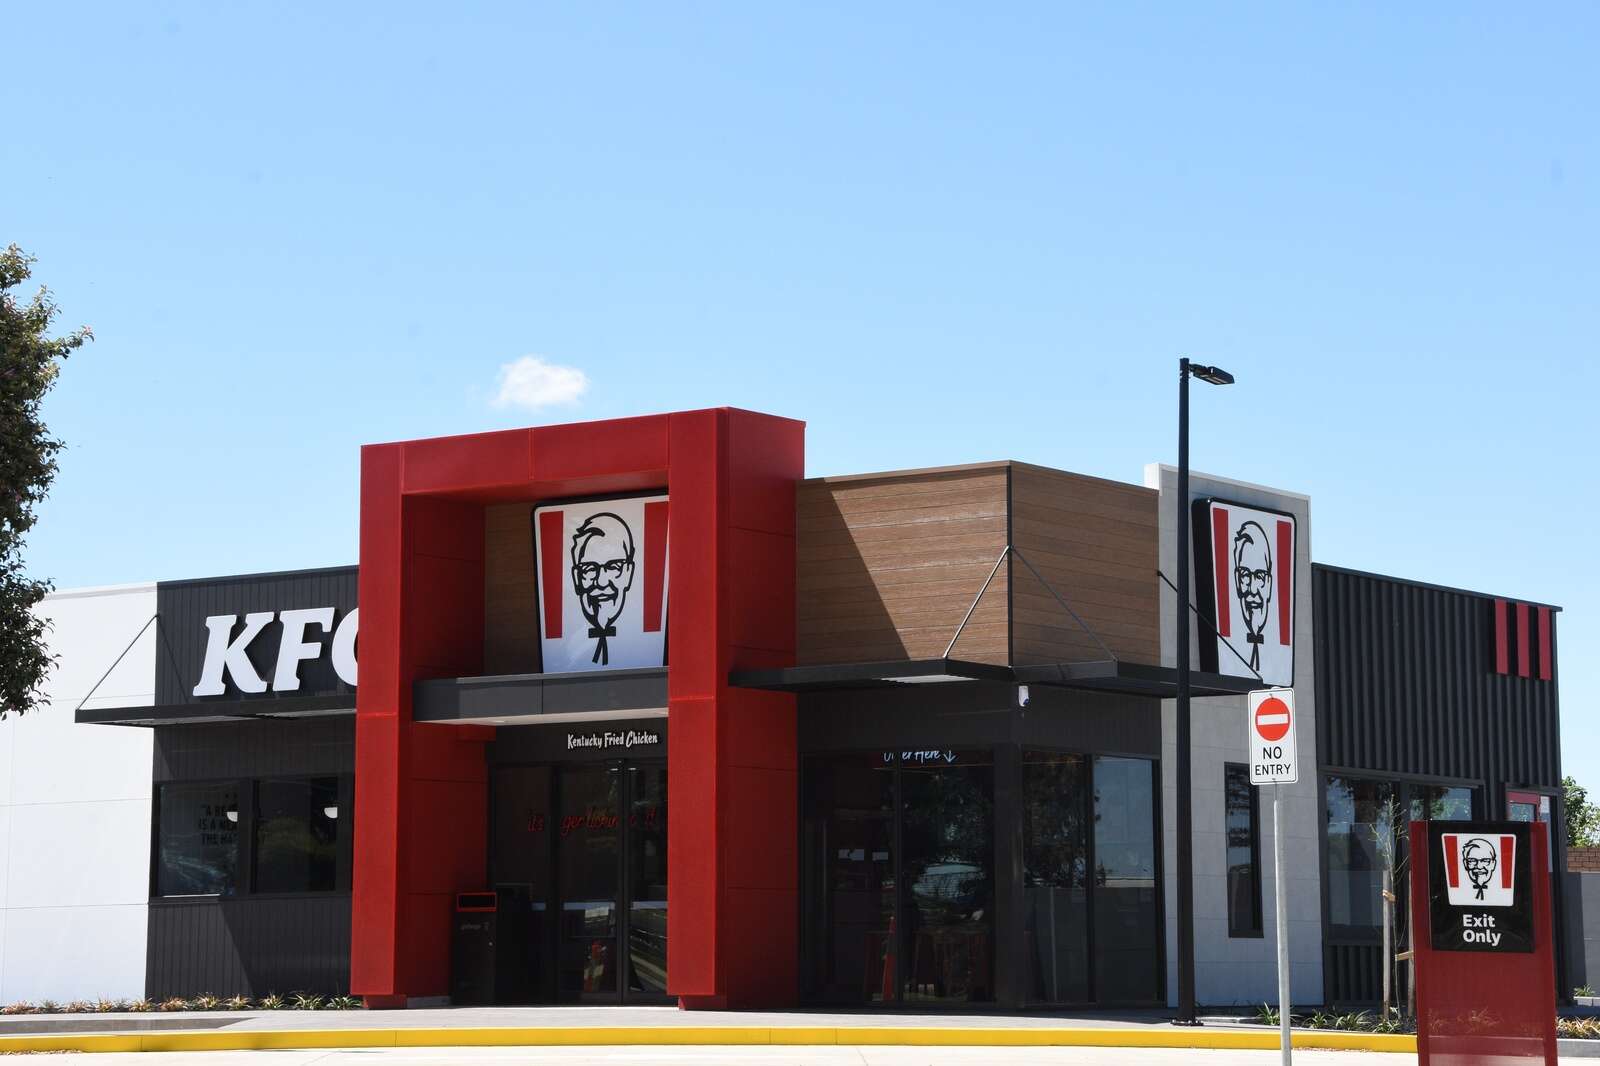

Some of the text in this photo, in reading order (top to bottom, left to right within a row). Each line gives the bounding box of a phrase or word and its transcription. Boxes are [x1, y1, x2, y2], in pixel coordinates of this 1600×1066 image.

[567, 731, 658, 749] Kentucky Fried Chicken
[1262, 746, 1282, 760] NO
[1255, 763, 1291, 776] ENTRY
[1462, 913, 1496, 928] Exit
[1462, 929, 1502, 947] Only
